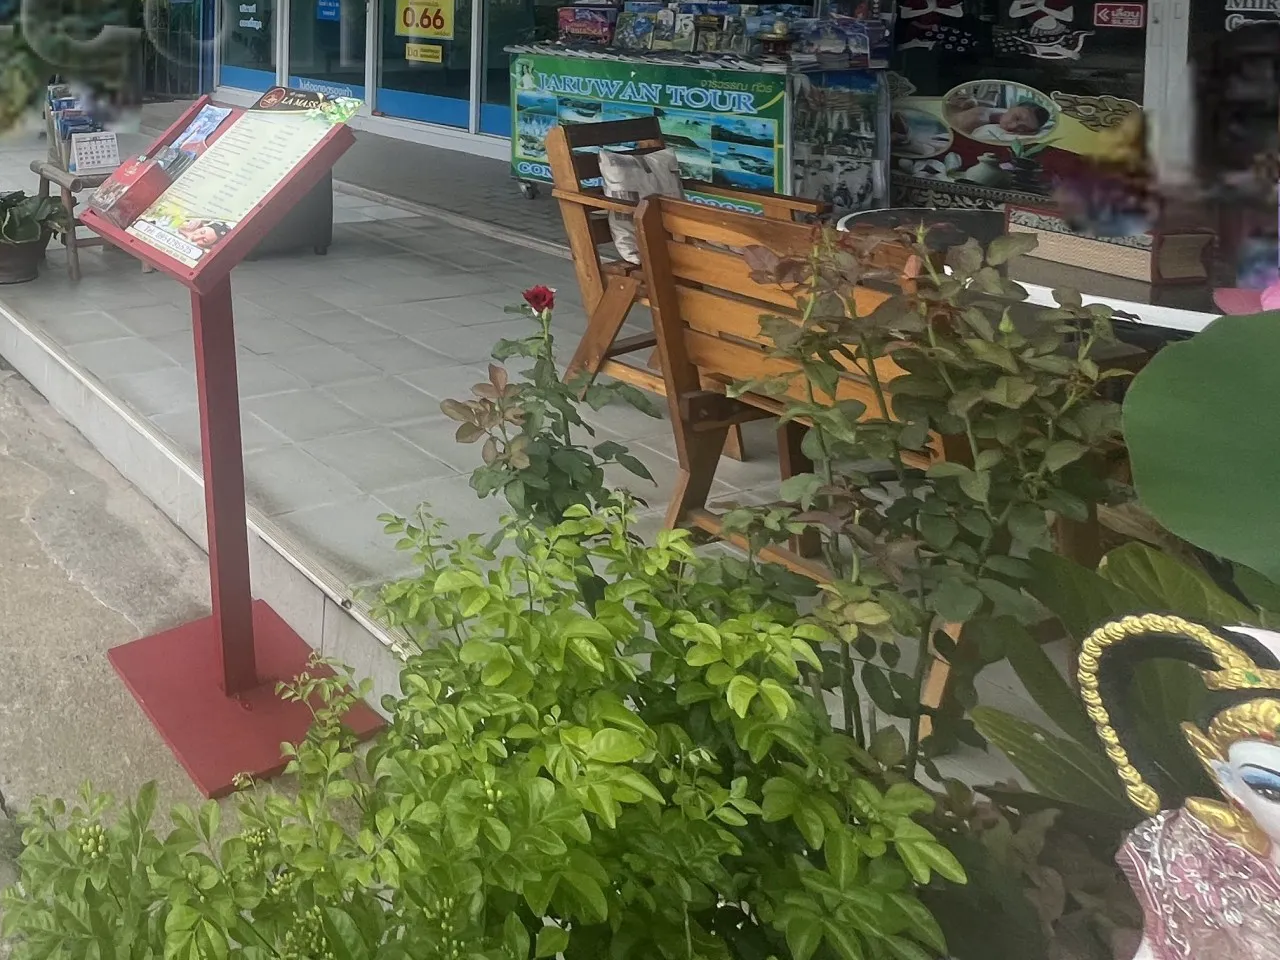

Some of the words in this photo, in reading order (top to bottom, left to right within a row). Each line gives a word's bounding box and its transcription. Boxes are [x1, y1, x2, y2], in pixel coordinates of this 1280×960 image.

[402, 6, 445, 30] 0.66
[538, 71, 662, 104] JARUWAN
[665, 84, 758, 114] TOUR
